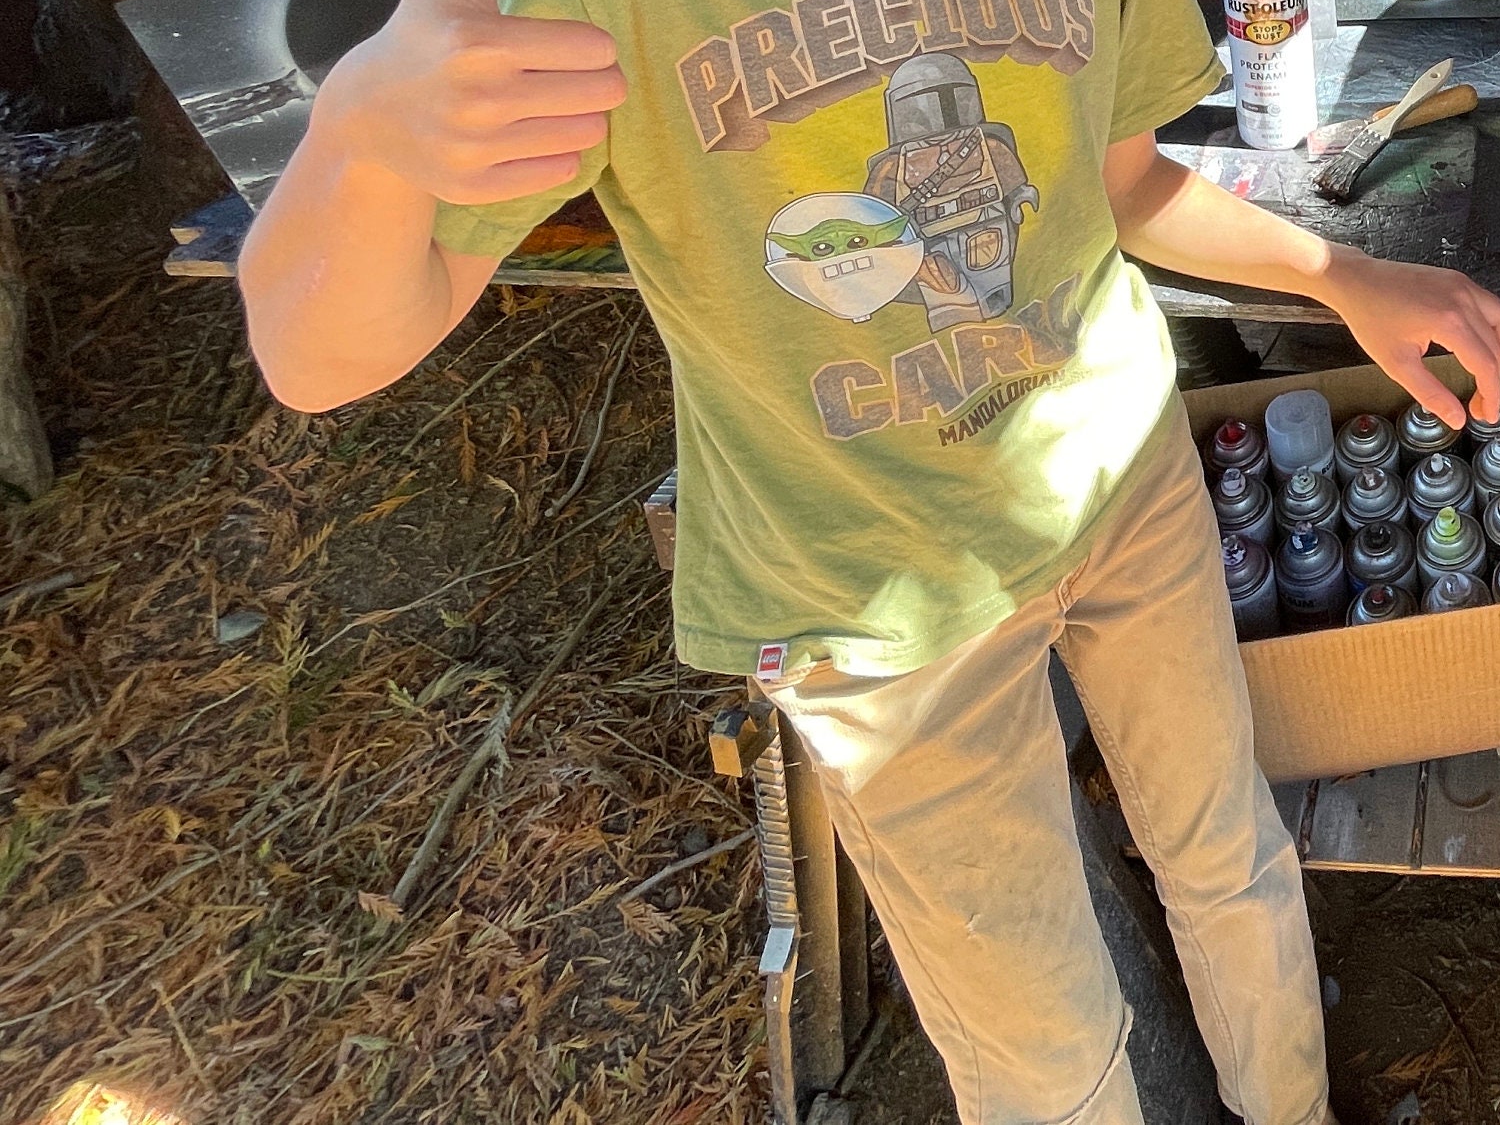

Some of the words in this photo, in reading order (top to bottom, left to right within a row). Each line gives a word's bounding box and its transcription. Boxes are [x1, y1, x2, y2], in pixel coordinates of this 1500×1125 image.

[1252, 24, 1284, 34] STOPS
[1255, 32, 1282, 41] RUST
[938, 369, 1066, 447] MANDALORIAN
